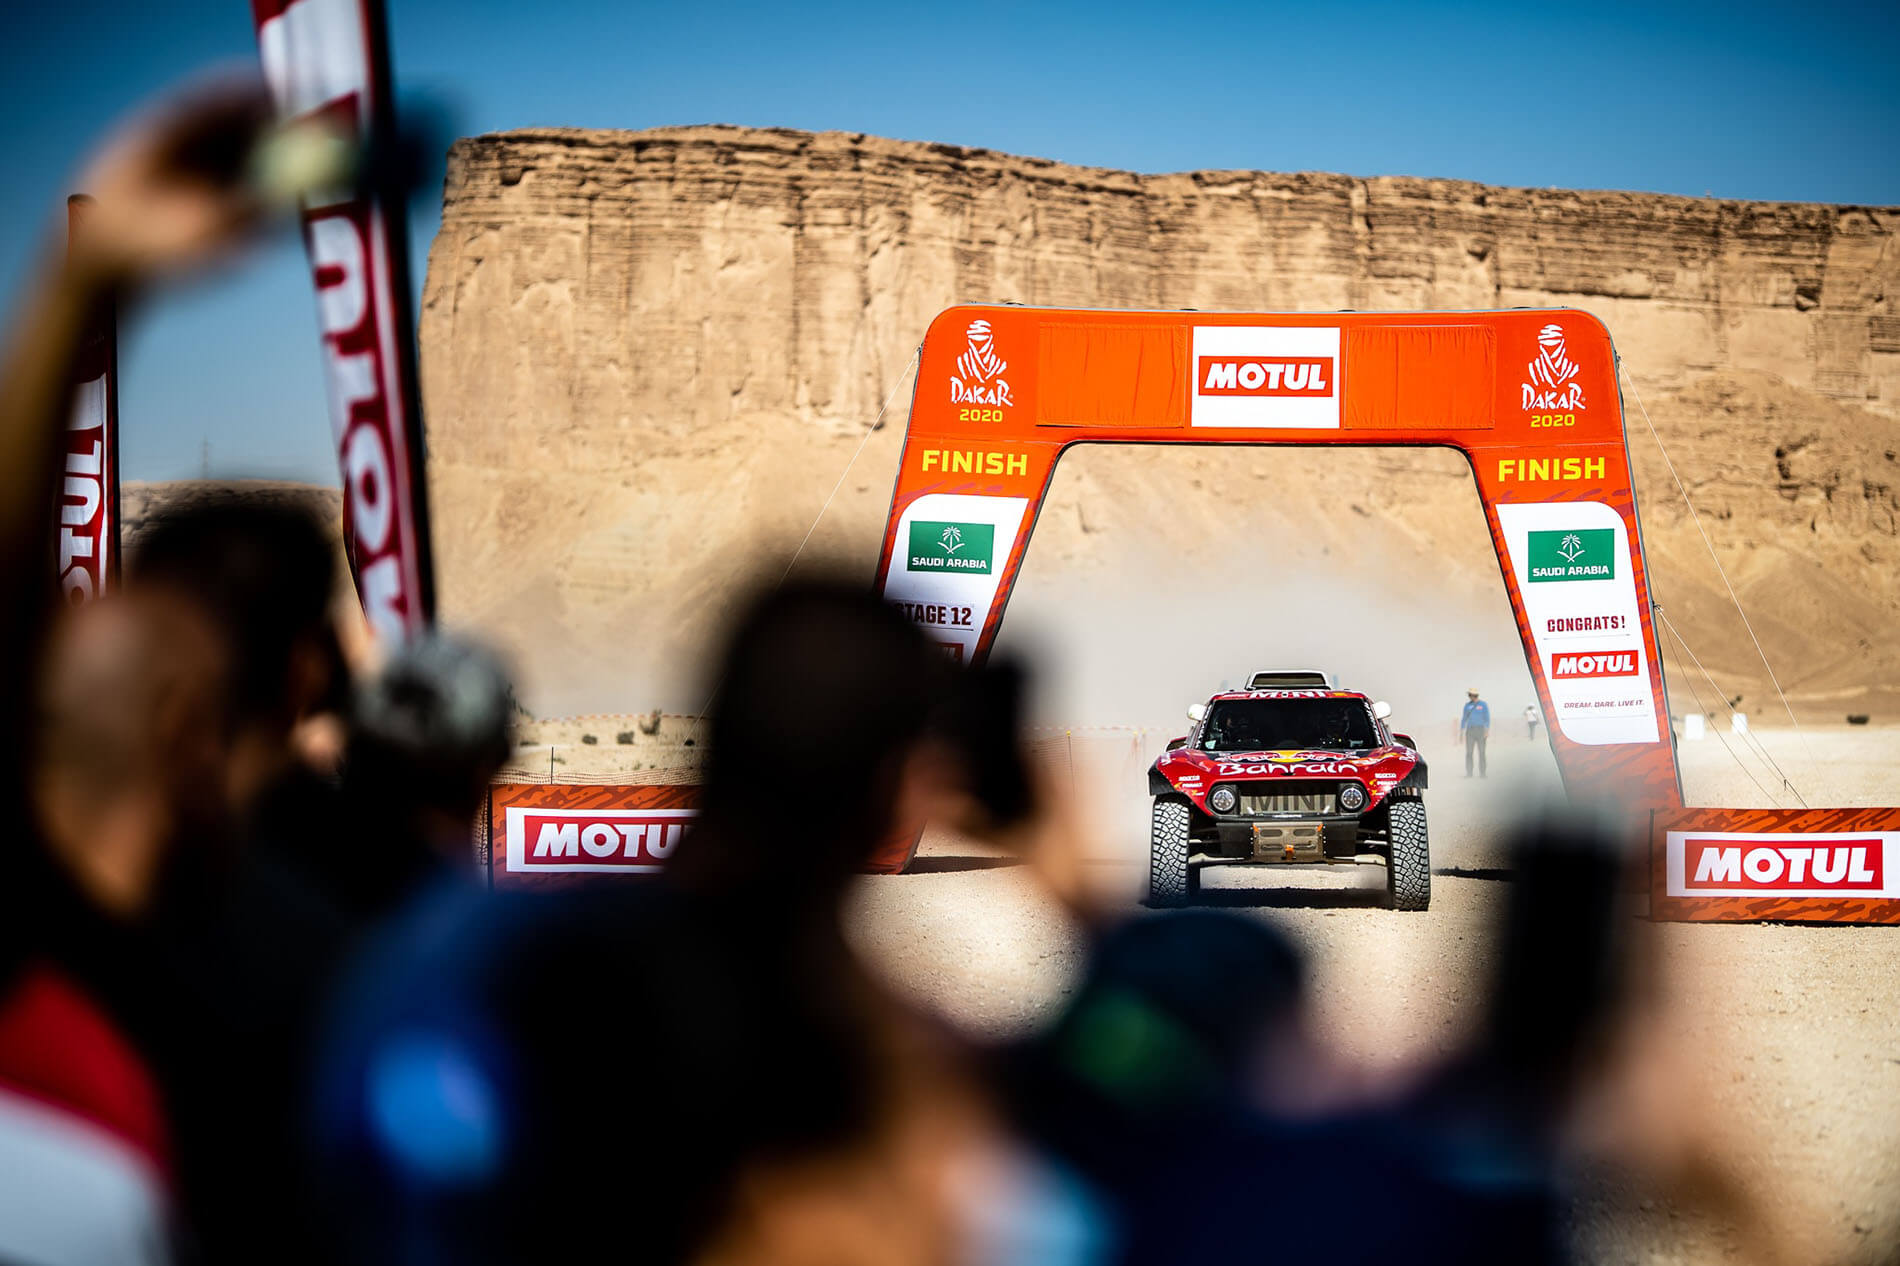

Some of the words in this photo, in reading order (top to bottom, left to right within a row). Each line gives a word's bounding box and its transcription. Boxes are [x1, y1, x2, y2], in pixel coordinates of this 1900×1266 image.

[1204, 362, 1327, 390] MOTUL
[950, 376, 1013, 407] DAKAR
[1521, 382, 1586, 411] DAKAR
[959, 408, 1003, 423] 2020
[1530, 413, 1576, 428] 2020
[921, 448, 1028, 476] FINISH
[1498, 456, 1606, 482] FINISH
[58, 439, 102, 606] OTUL
[911, 556, 944, 567] SAUDI
[946, 558, 987, 569] ARABIA
[1532, 566, 1565, 577] SAUDI
[1567, 565, 1610, 576] ARABIA
[950, 606, 972, 626] 12
[1547, 615, 1626, 633] CONGRATS!
[1556, 654, 1634, 675] MOTUL
[1218, 762, 1358, 775] Bahrain
[1251, 788, 1326, 811] MINI
[532, 822, 695, 859] MOTU
[1693, 847, 1875, 884] MOTUL
